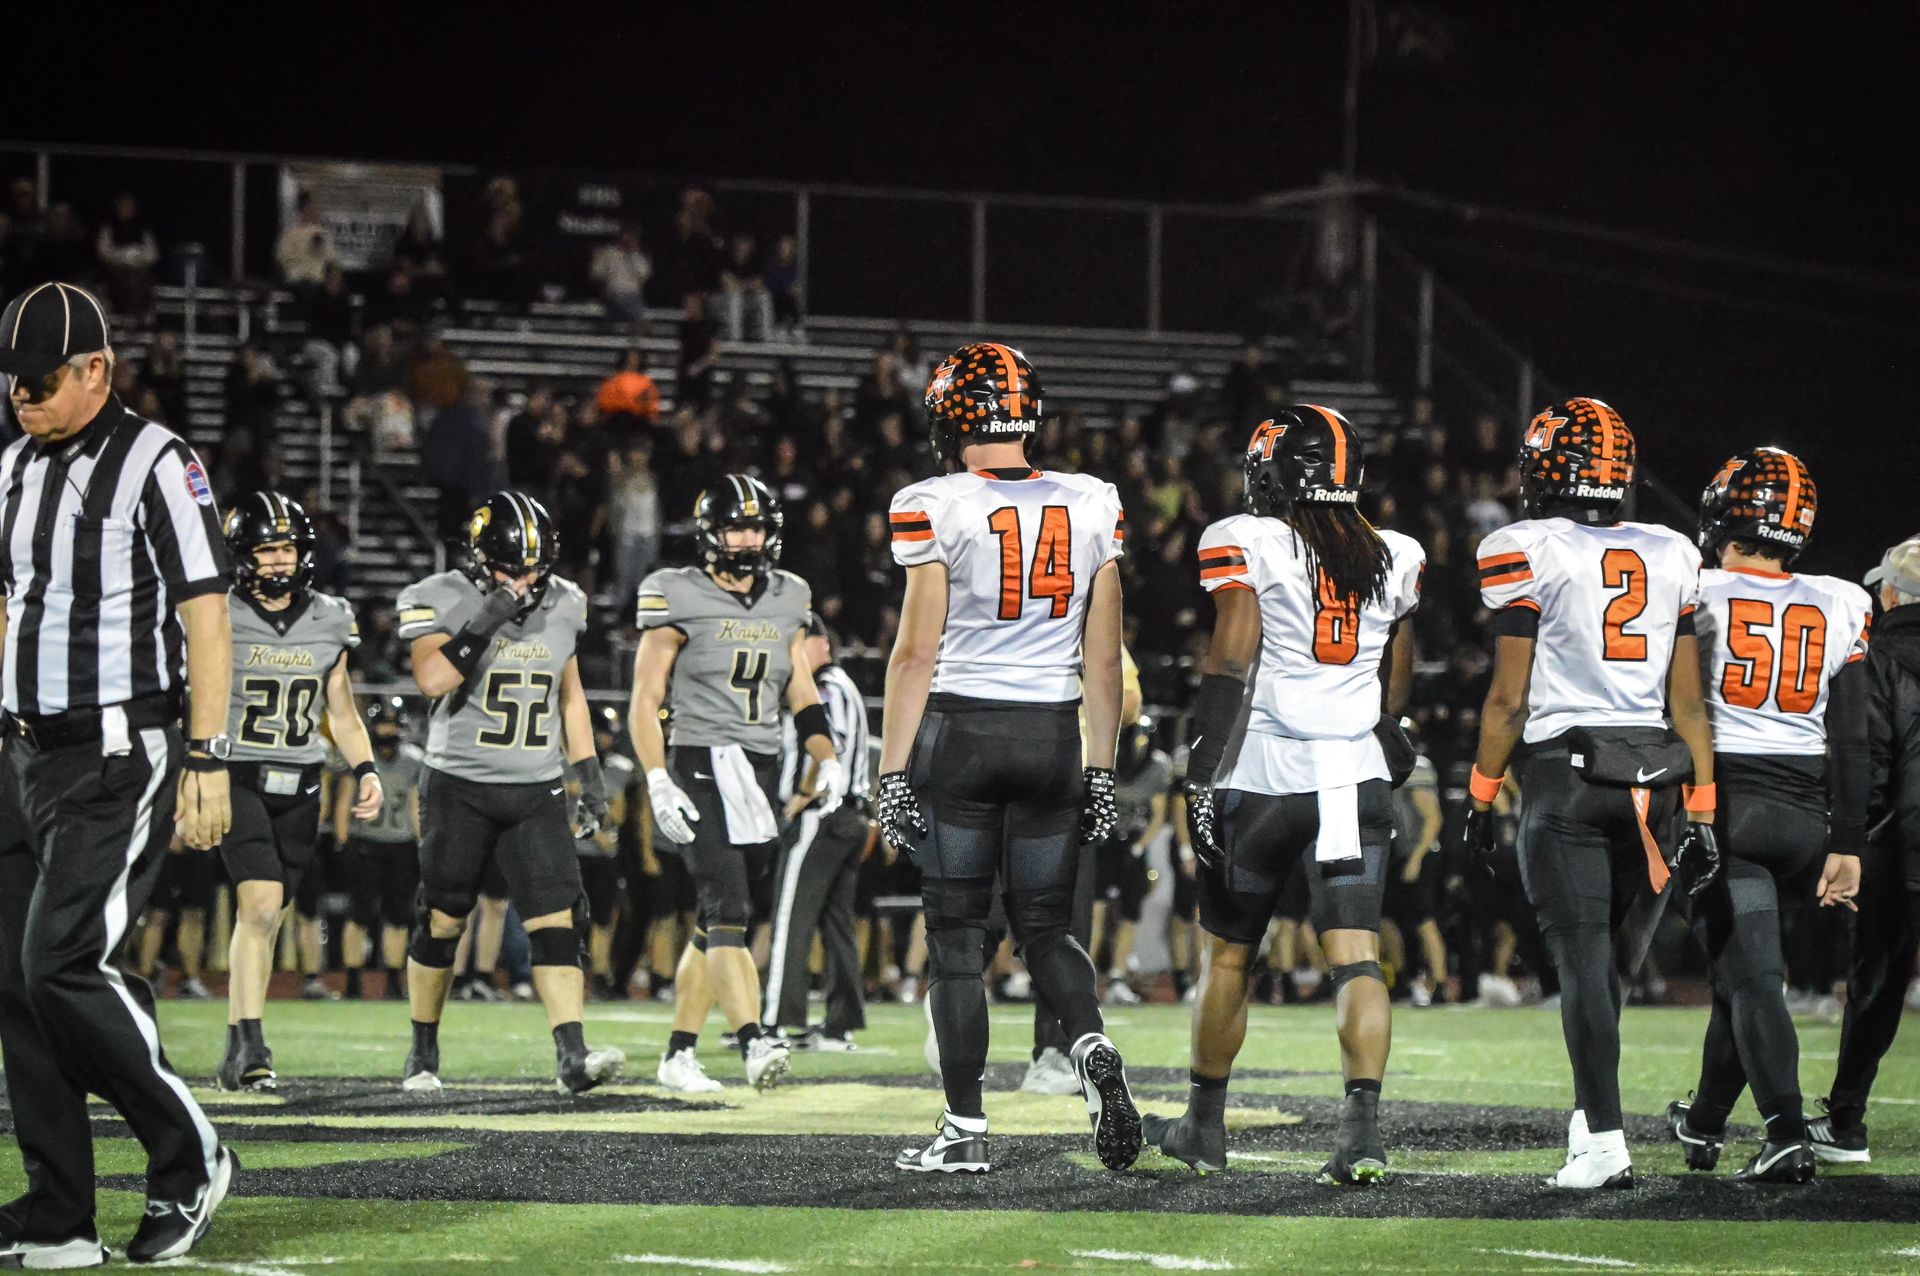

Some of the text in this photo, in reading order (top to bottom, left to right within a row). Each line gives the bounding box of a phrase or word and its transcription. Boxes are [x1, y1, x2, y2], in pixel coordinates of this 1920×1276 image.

[989, 419, 1036, 433] Riddell
[1248, 419, 1289, 462] CT
[1525, 411, 1569, 452] CT
[1313, 488, 1359, 503] Riddell
[1576, 484, 1625, 500] Riddell
[1757, 525, 1804, 545] Riddell
[988, 505, 1075, 620] 14
[1600, 548, 1648, 662] 2
[491, 638, 553, 666] Knights
[715, 618, 783, 645] Knights
[244, 644, 316, 672] Knights
[1720, 598, 1828, 714] 50
[727, 648, 770, 725] 4
[238, 675, 322, 749] 20
[475, 668, 555, 751] 52
